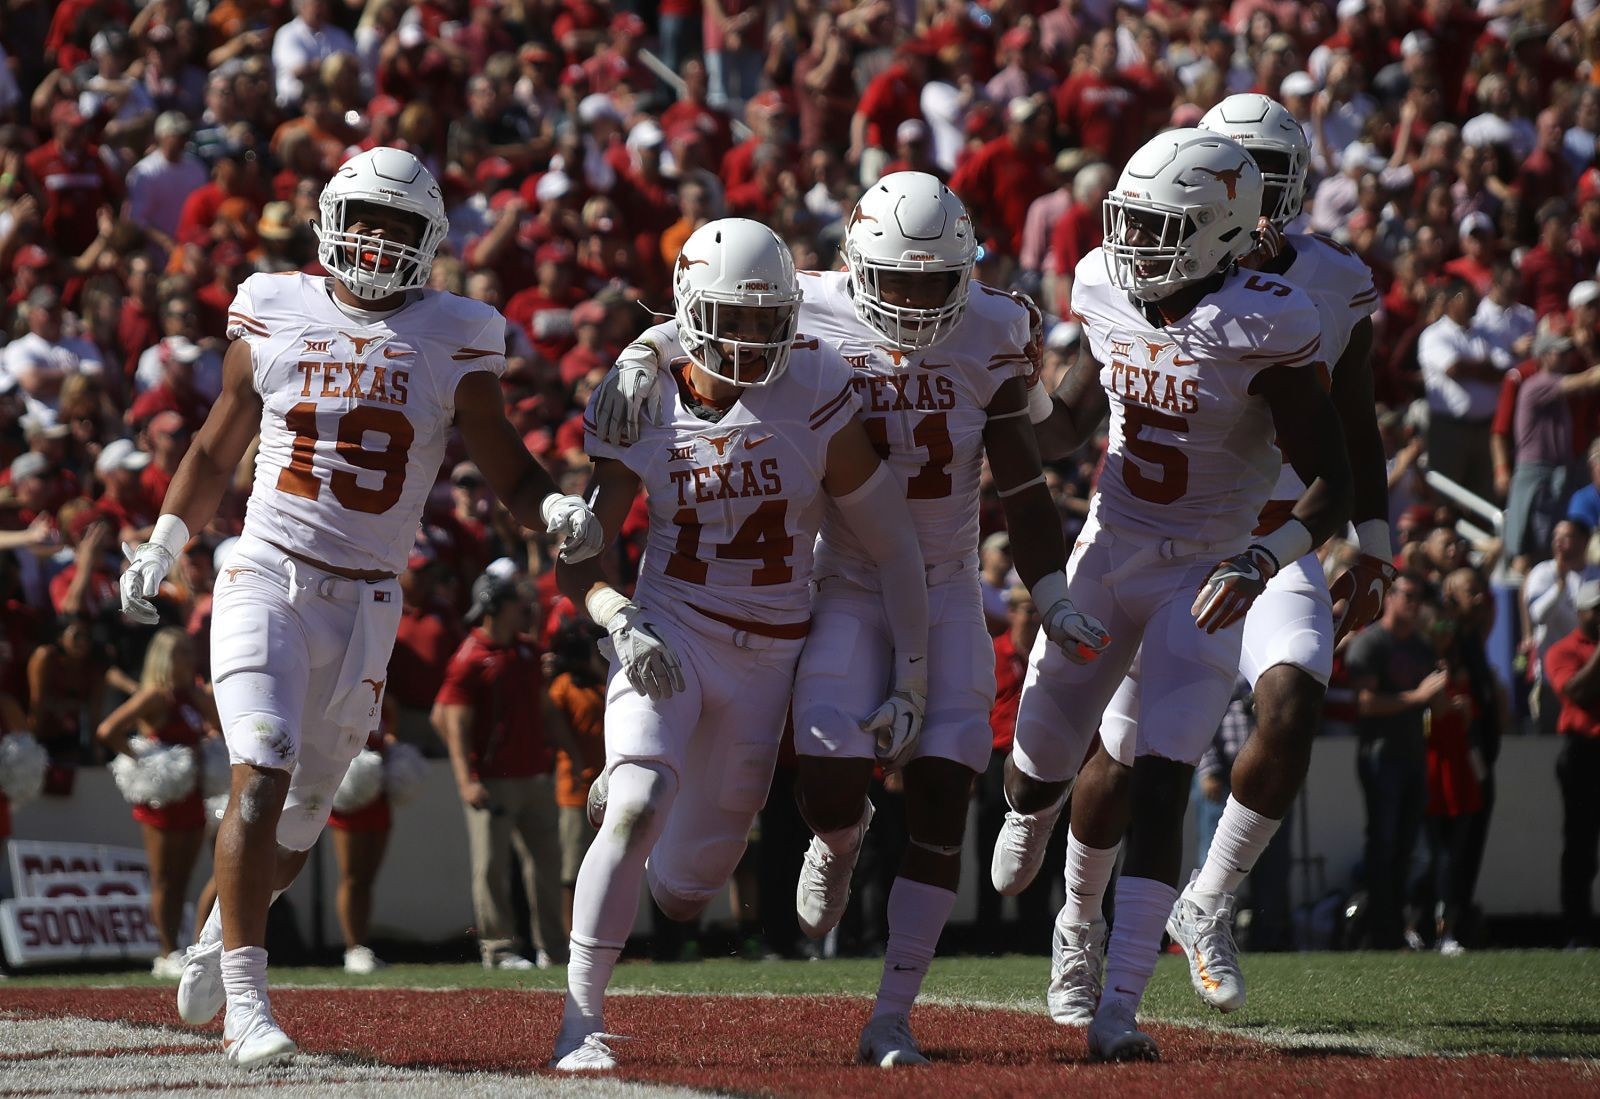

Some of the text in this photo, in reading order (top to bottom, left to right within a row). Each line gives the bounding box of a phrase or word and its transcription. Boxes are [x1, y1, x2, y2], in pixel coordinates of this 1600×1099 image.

[745, 282, 769, 291] HORNS
[298, 361, 409, 405] TEXAS
[850, 374, 956, 413] TEXAS
[1110, 359, 1199, 414] TEXAS
[275, 402, 415, 515] 19
[1122, 402, 1189, 505] 5
[670, 458, 782, 506] TEXAS
[664, 499, 794, 587] 14
